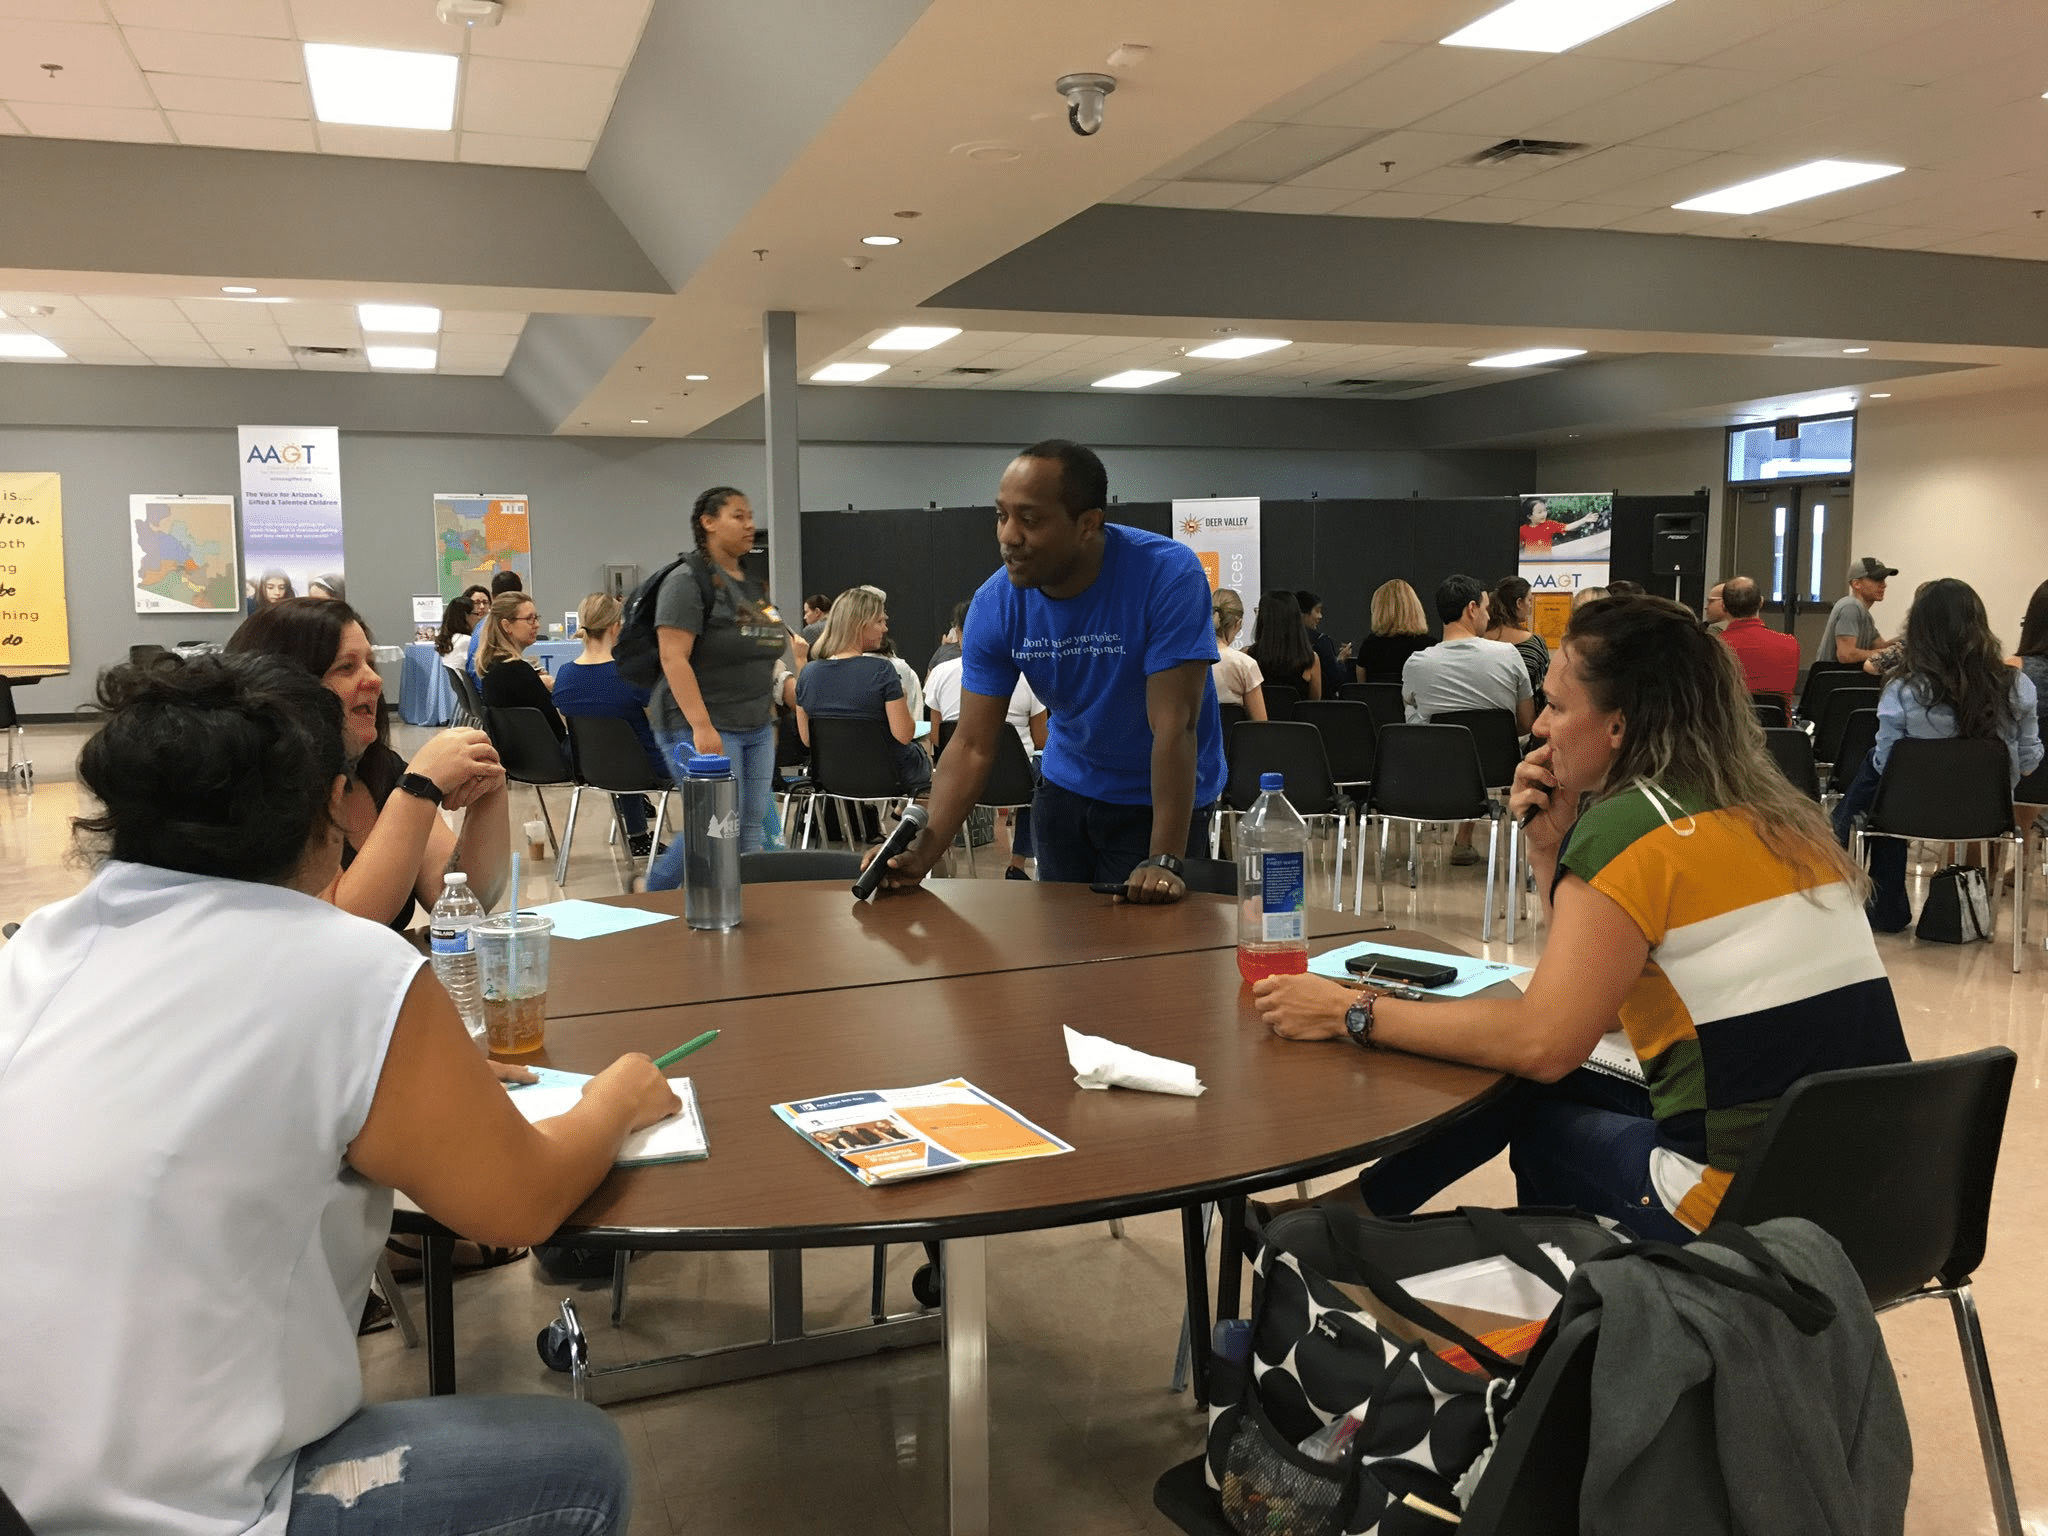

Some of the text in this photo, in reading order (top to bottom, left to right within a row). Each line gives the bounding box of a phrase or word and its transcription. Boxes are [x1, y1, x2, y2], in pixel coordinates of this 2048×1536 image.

[247, 445, 315, 464] AAGT
[1205, 517, 1248, 527] DEER VALLEY
[1227, 553, 1243, 594] vices
[1533, 574, 1582, 588] AAGT
[1022, 636, 1049, 648] Don't
[1011, 648, 1056, 661] Improve
